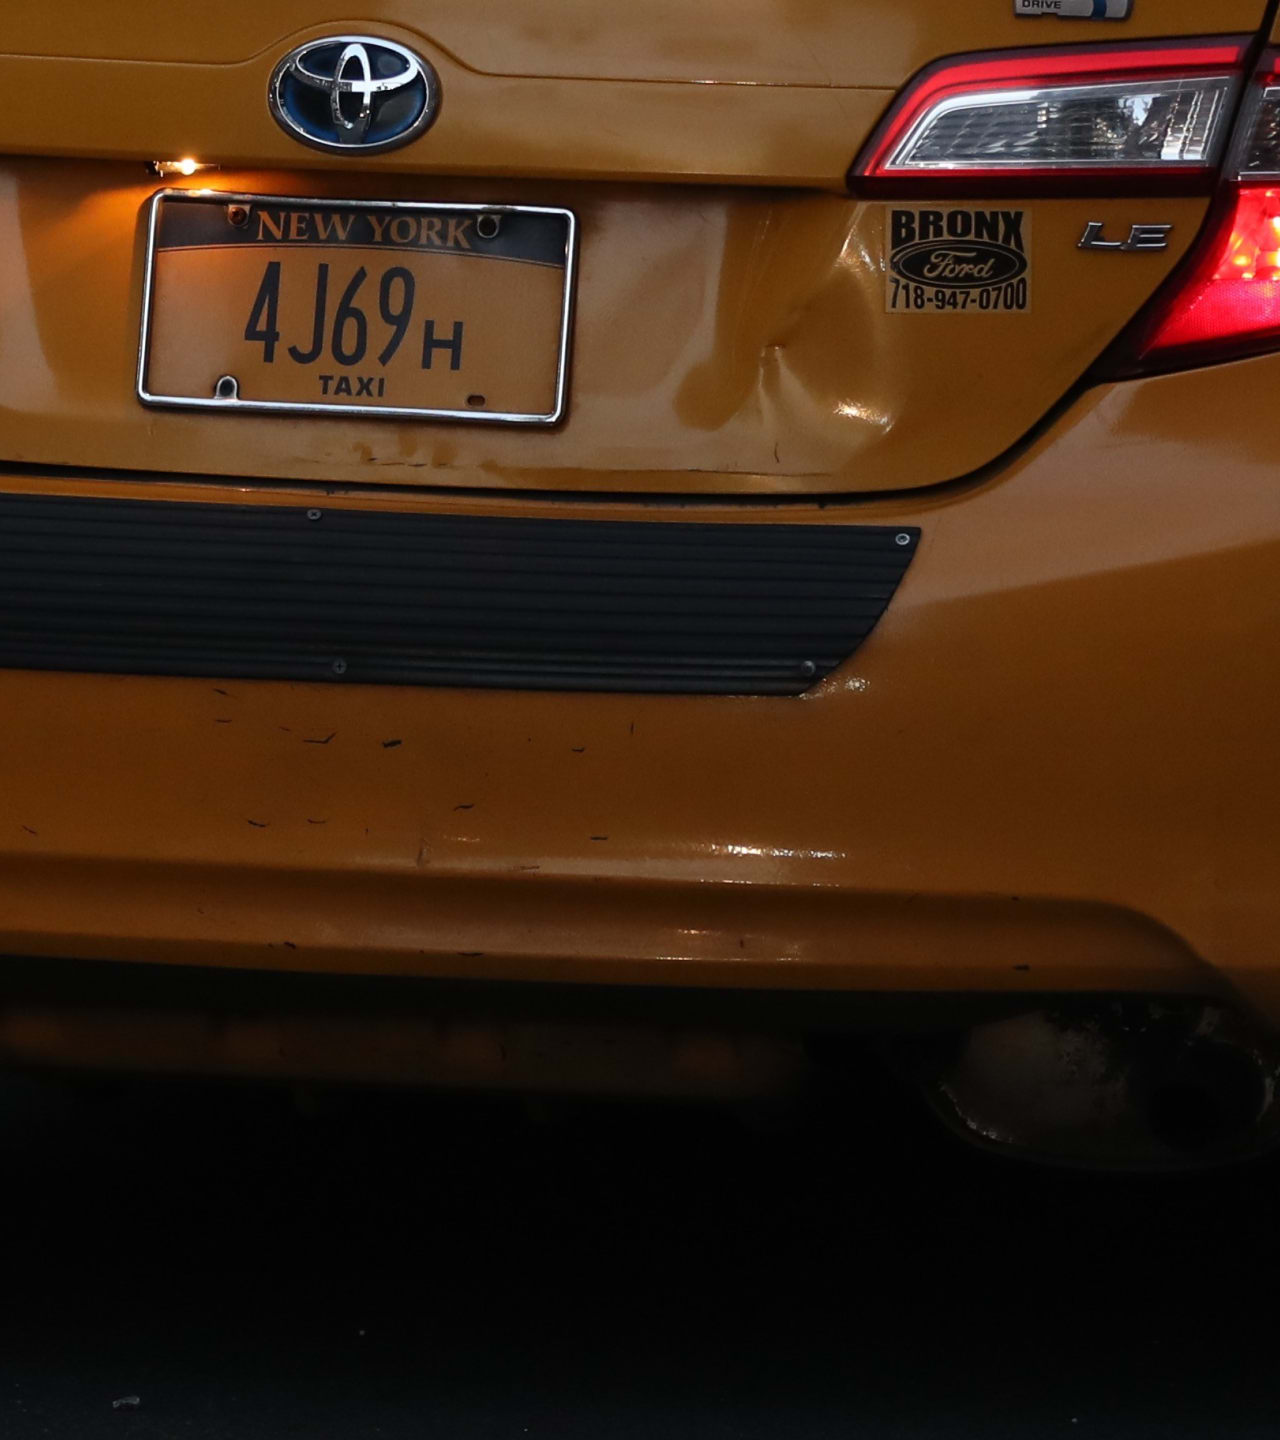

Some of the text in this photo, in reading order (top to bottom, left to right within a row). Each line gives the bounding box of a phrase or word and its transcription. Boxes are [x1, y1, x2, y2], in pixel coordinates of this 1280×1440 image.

[1022, 0, 1062, 10] DRIVE
[256, 210, 473, 250] NEW YORK
[891, 210, 1025, 255] BRONX
[1076, 221, 1174, 252] LE
[923, 250, 996, 278] Ford
[889, 276, 1028, 310] 718-947-0700
[319, 374, 386, 398] TAXI
